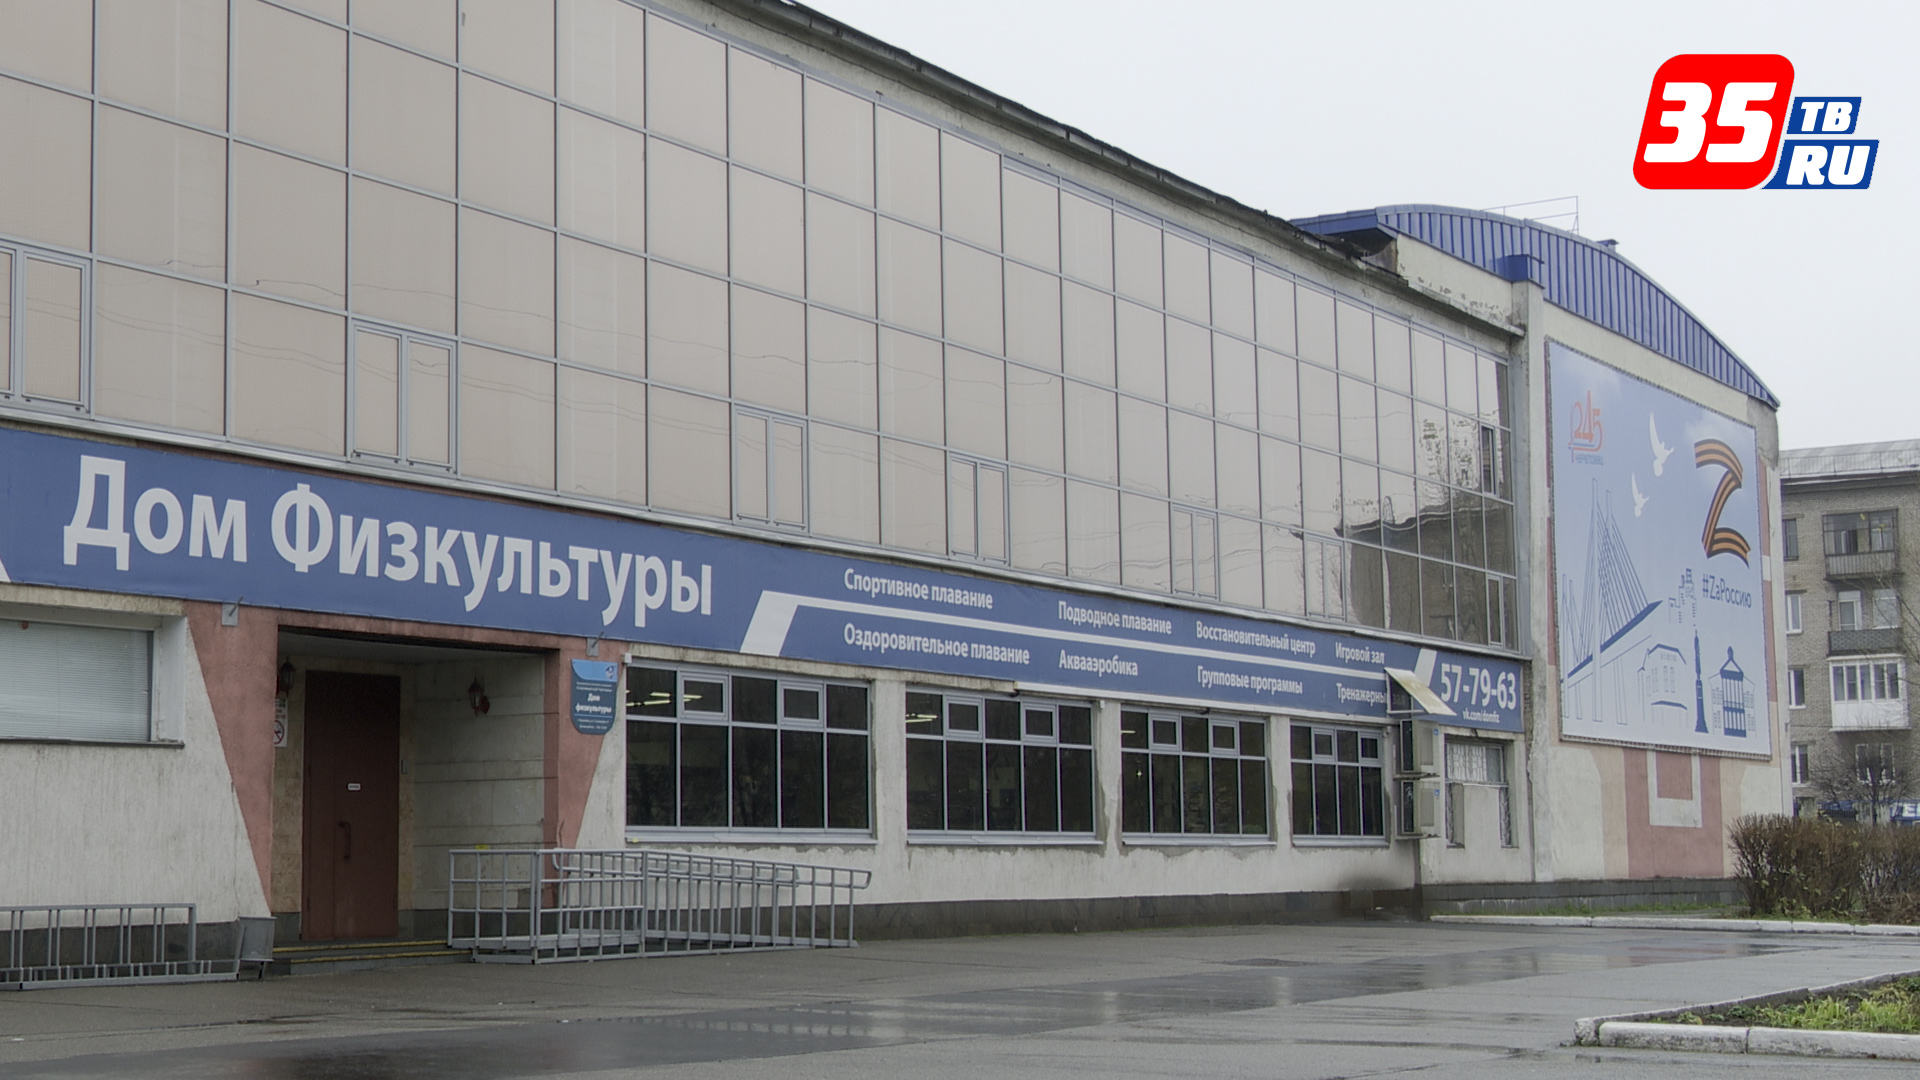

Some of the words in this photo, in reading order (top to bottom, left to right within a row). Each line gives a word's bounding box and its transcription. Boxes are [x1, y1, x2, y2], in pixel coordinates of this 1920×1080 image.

[63, 455, 247, 571] Дом
[271, 483, 712, 627] Физкультуры
[844, 568, 928, 598] Спортивное
[931, 585, 993, 609] плавание
[1702, 574, 1752, 608] #ZaРоссию
[1058, 600, 1120, 628] Подводное
[1121, 611, 1172, 635] плавание
[844, 623, 968, 658] Оздоровительное
[971, 642, 1030, 665] плавание
[1196, 620, 1289, 651] Восстановительный
[1290, 639, 1315, 658] центр
[1335, 642, 1370, 664] Игровой
[1371, 651, 1385, 664] зал
[1058, 650, 1138, 677] Аквааэробика
[1197, 665, 1249, 689] Групповые
[1250, 676, 1303, 695] программы
[587, 693, 601, 702] Дом
[1336, 682, 1387, 707] Тренажерны
[1441, 663, 1516, 710] 57-79-63
[575, 703, 612, 715] физкультуры
